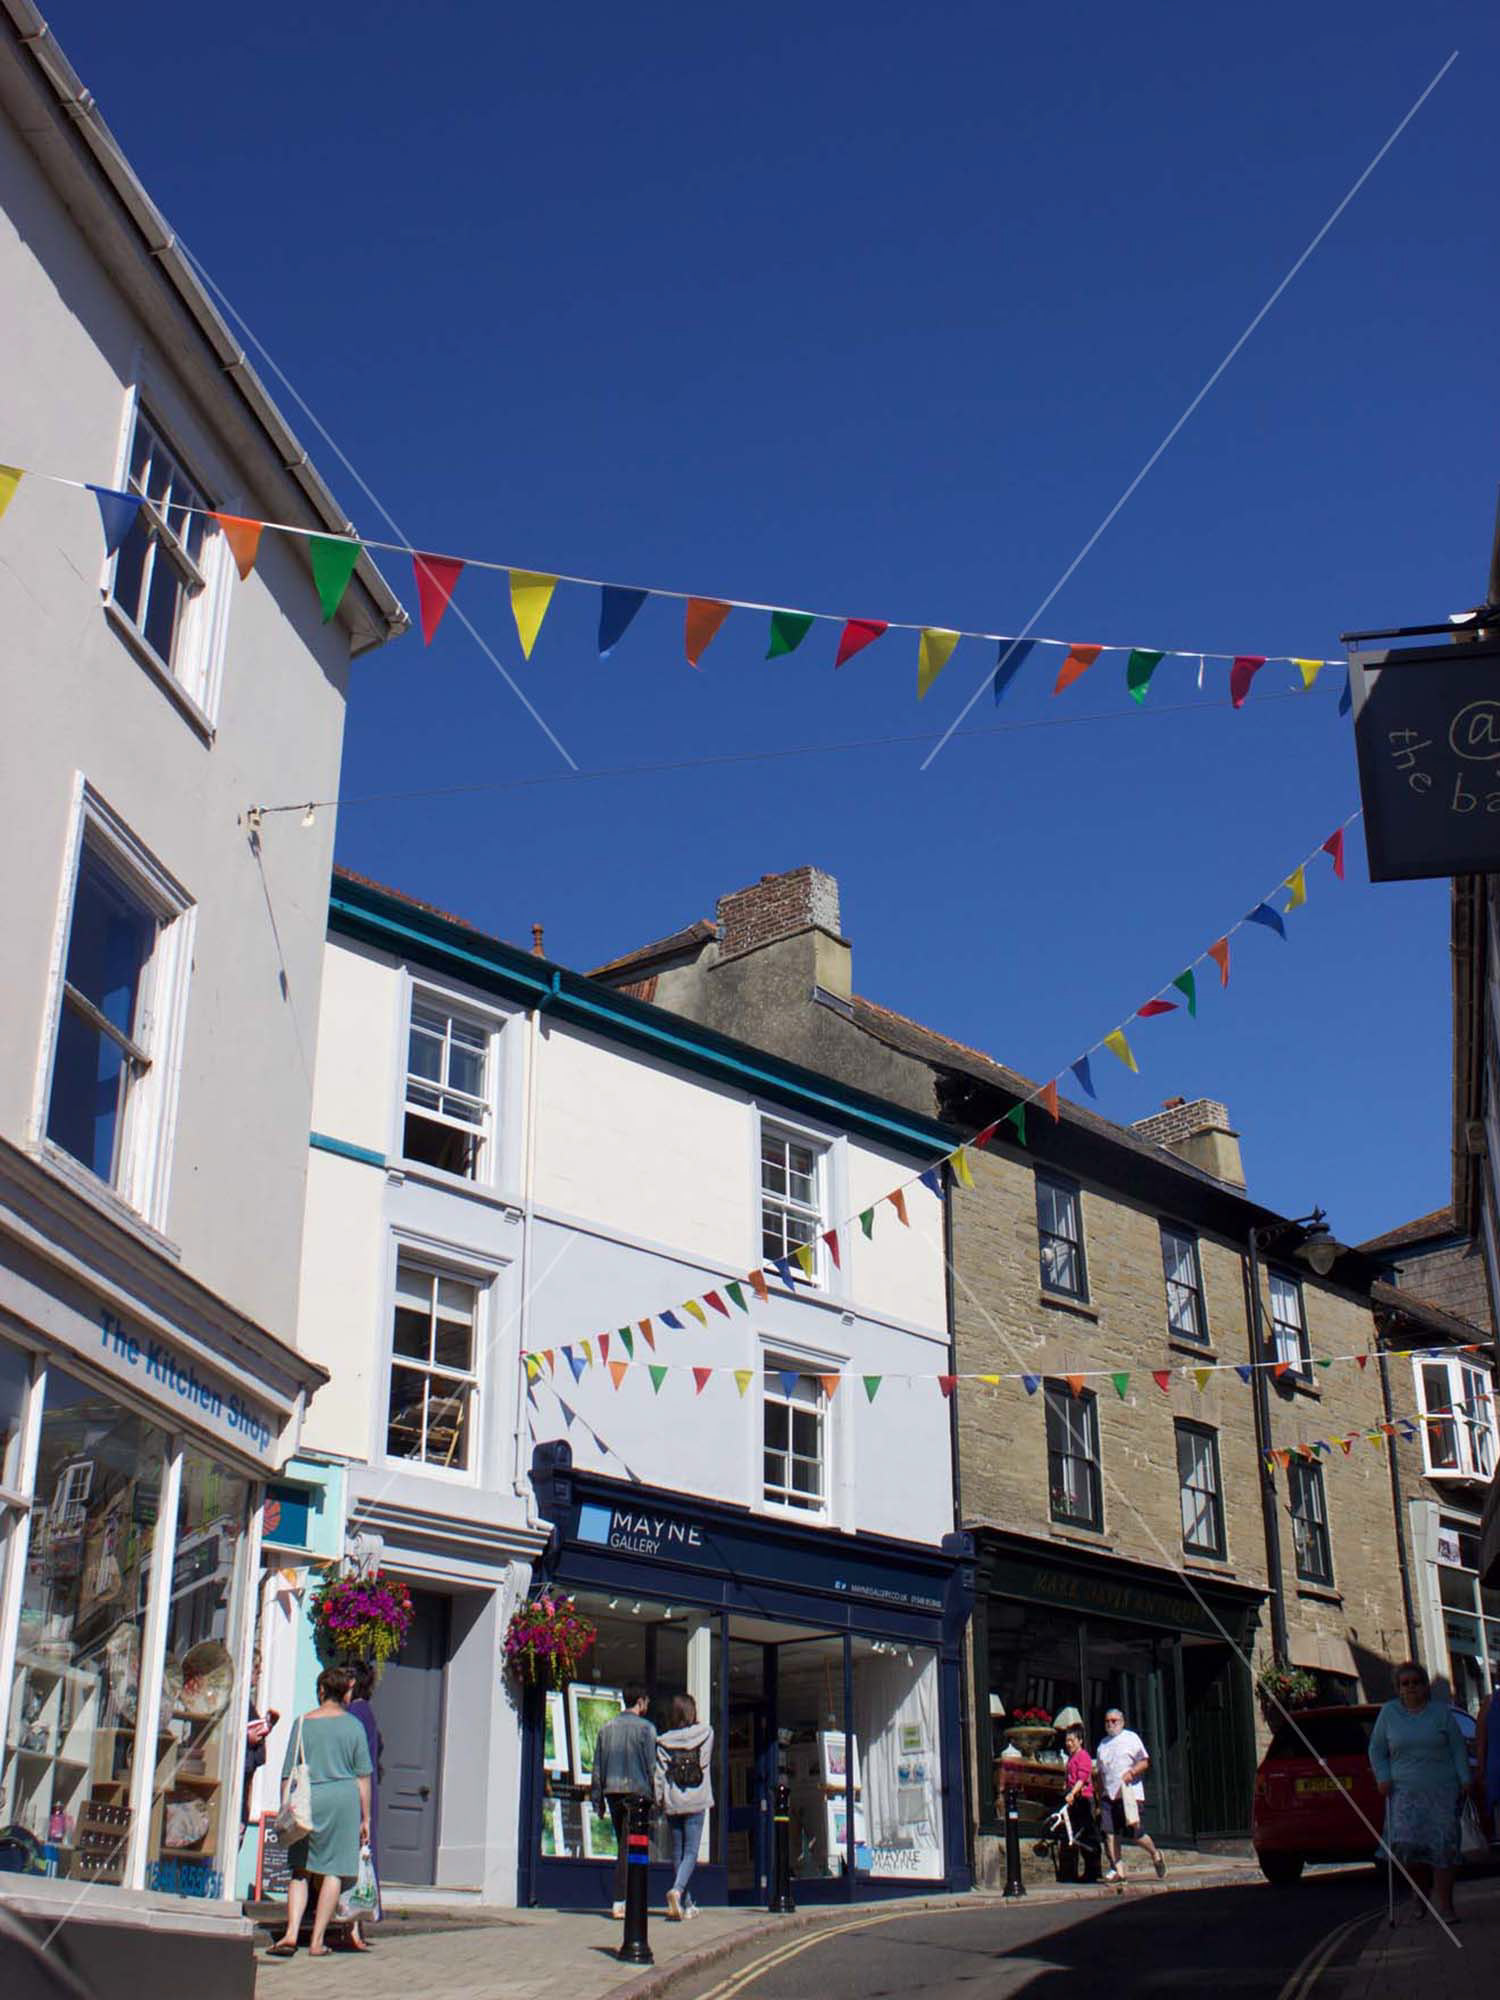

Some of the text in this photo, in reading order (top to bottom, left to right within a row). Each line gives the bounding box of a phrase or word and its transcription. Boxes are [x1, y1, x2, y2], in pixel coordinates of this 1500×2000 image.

[1389, 727, 1433, 793] the
[100, 1309, 271, 1452] The Kitchen Shop
[610, 1532, 660, 1555] GALLERY
[613, 1510, 703, 1546] MAYNE
